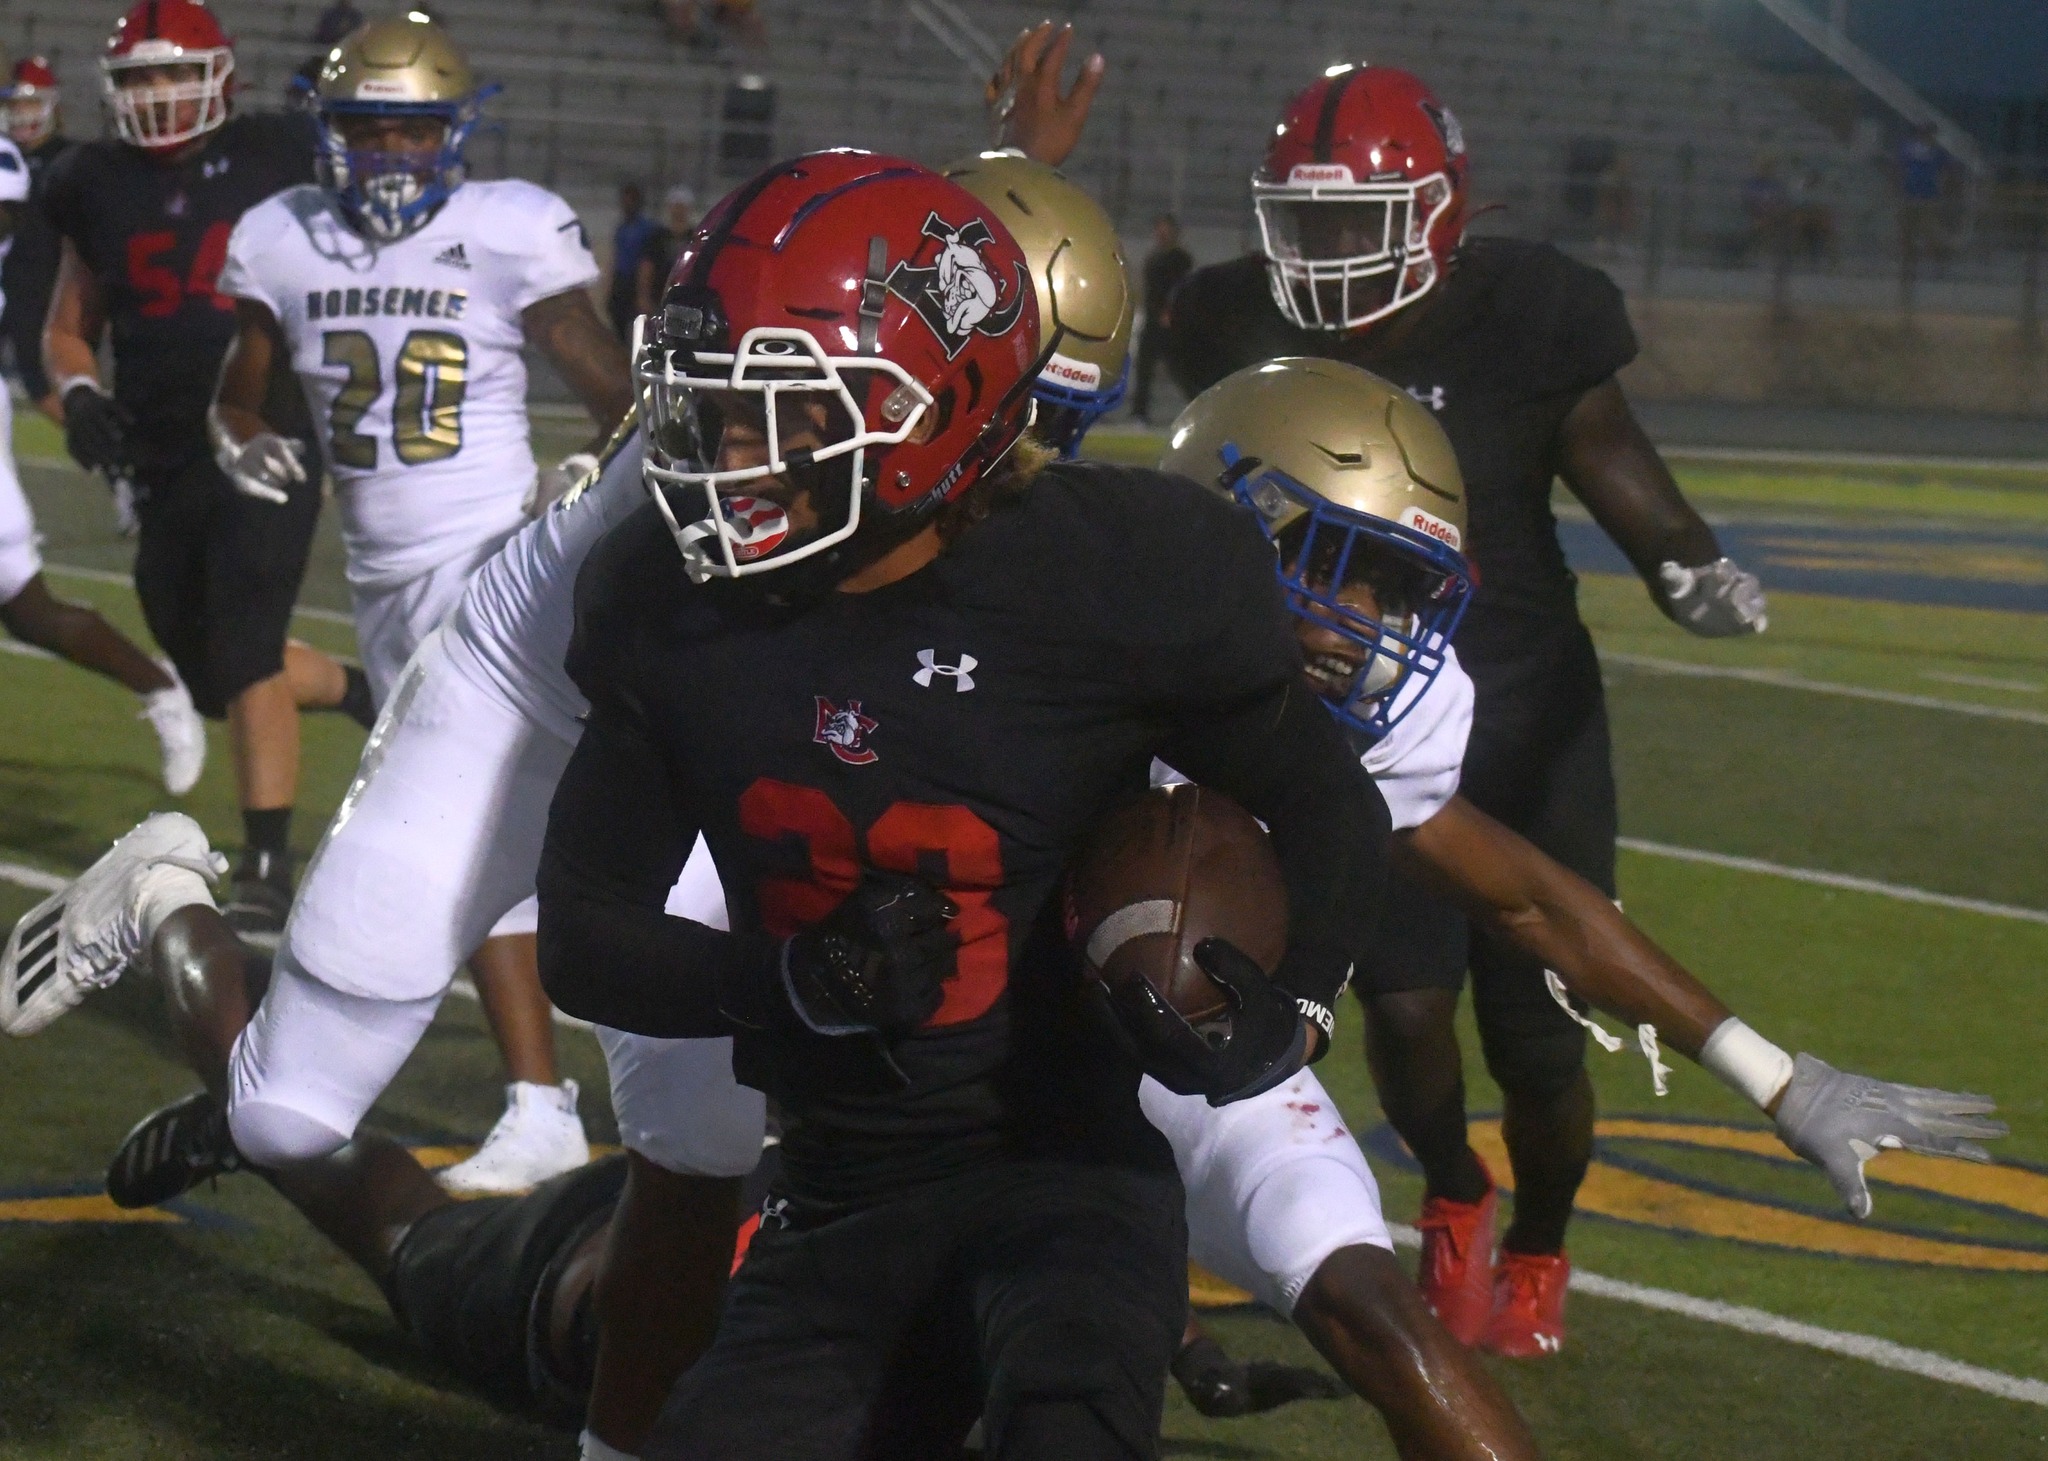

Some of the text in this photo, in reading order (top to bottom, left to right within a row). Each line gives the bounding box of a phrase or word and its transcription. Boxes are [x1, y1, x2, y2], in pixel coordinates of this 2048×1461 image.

[321, 329, 469, 470] 20
[926, 463, 963, 502] hutt
[738, 777, 1009, 1028] 23
